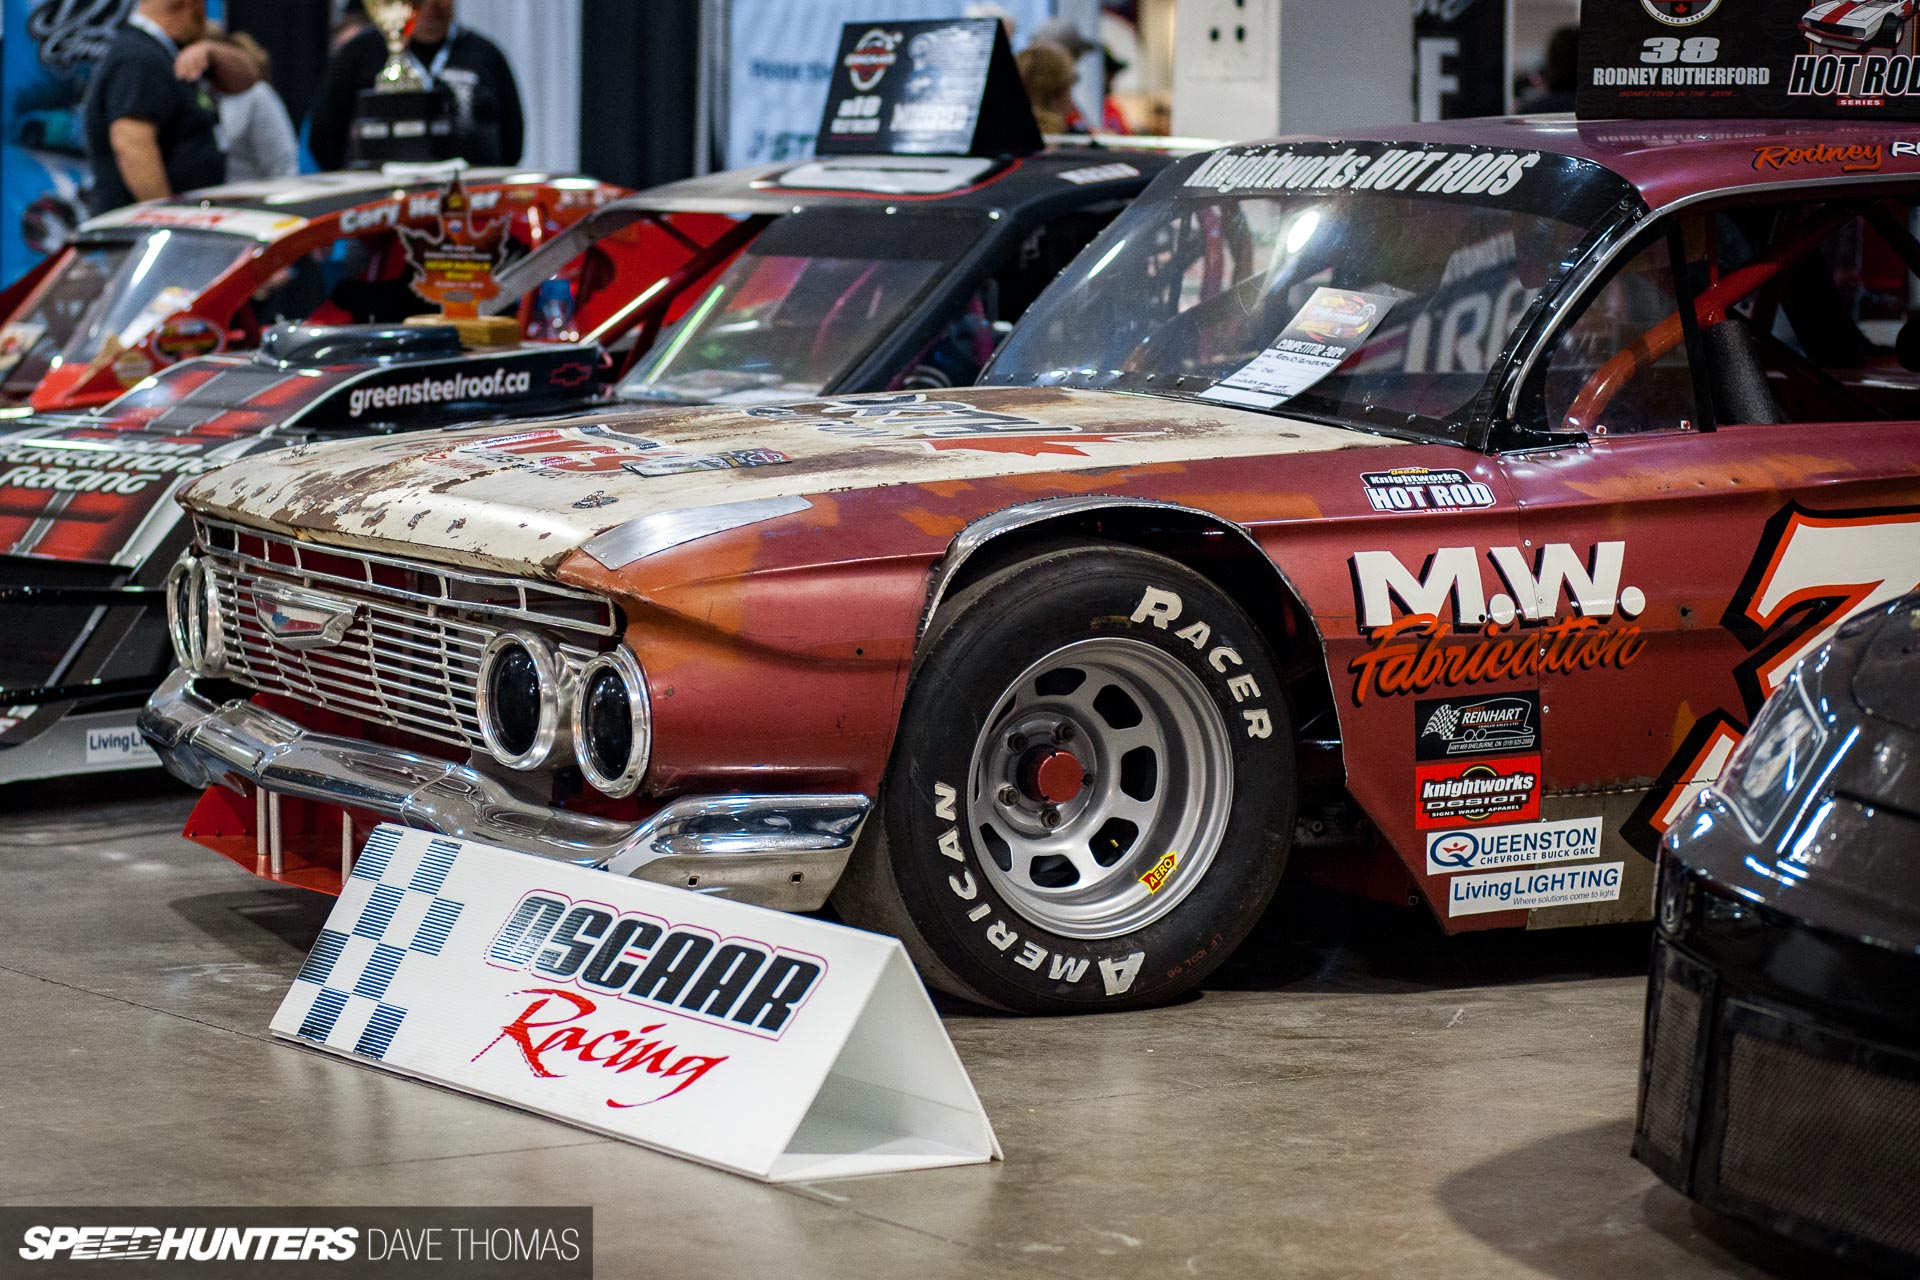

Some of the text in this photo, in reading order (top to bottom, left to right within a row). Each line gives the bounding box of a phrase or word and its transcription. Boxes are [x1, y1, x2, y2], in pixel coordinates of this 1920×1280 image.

[1640, 37, 1720, 63] 38
[1593, 67, 1770, 86] RODNEY RUTHERFORD
[1788, 55, 1862, 95] HOT
[1183, 149, 1372, 193] Knightworks
[1350, 149, 1448, 191] HOT
[1416, 151, 1541, 196] RODS
[1752, 142, 1920, 172] Rodney R
[349, 368, 530, 417] greensteelroof.ca
[1367, 484, 1495, 510] HOT ROD
[1354, 541, 1646, 627] M.W.
[1130, 586, 1273, 740] RACER
[1351, 613, 1648, 702] Fabrication
[1461, 707, 1523, 725] REINHART
[1423, 774, 1534, 798] knightworks
[1431, 810, 1454, 818] SIGNS
[1487, 804, 1519, 812] APPAREL
[1429, 826, 1597, 867] QUEENSTON
[1480, 846, 1595, 865] CHEVROLET BUICK GMC
[934, 781, 1146, 997] AMERICAN
[1149, 858, 1173, 888] AERO
[1512, 896, 1536, 906] Where
[1537, 893, 1568, 904] solutions
[1569, 893, 1590, 901] come
[489, 896, 821, 1033] OSCAAR
[471, 988, 731, 1109] Racing
